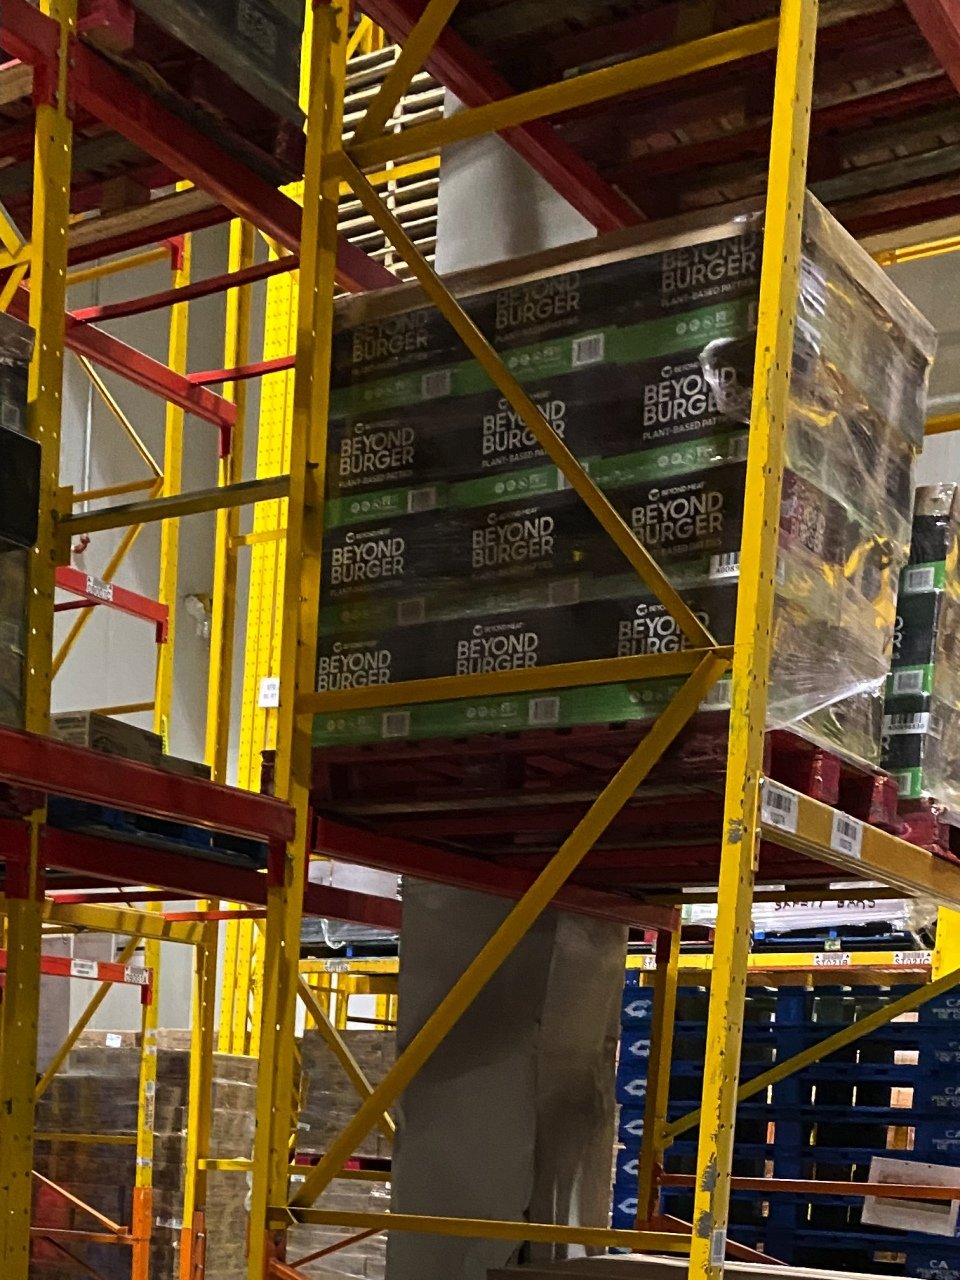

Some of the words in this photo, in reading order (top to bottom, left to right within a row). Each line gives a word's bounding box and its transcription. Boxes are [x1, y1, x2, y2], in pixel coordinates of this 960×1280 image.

[661, 251, 756, 292] BURGER
[496, 292, 580, 329] BURGER
[353, 329, 429, 362] BURGER
[341, 427, 415, 457] BEYOND
[482, 420, 566, 455] BURGR
[643, 421, 701, 441] PLANT-BASED
[340, 447, 414, 476] BURGER
[632, 492, 724, 527] BEYOND
[472, 516, 554, 549] BEYOND
[634, 512, 723, 546] BURGER
[332, 537, 405, 566] BEYOND
[472, 536, 554, 568] BURGER
[331, 557, 404, 585] BURGER
[457, 632, 538, 659] BEYOND
[319, 649, 391, 675] BEYOND
[456, 652, 538, 676] BURGER
[318, 669, 391, 692] BURGER
